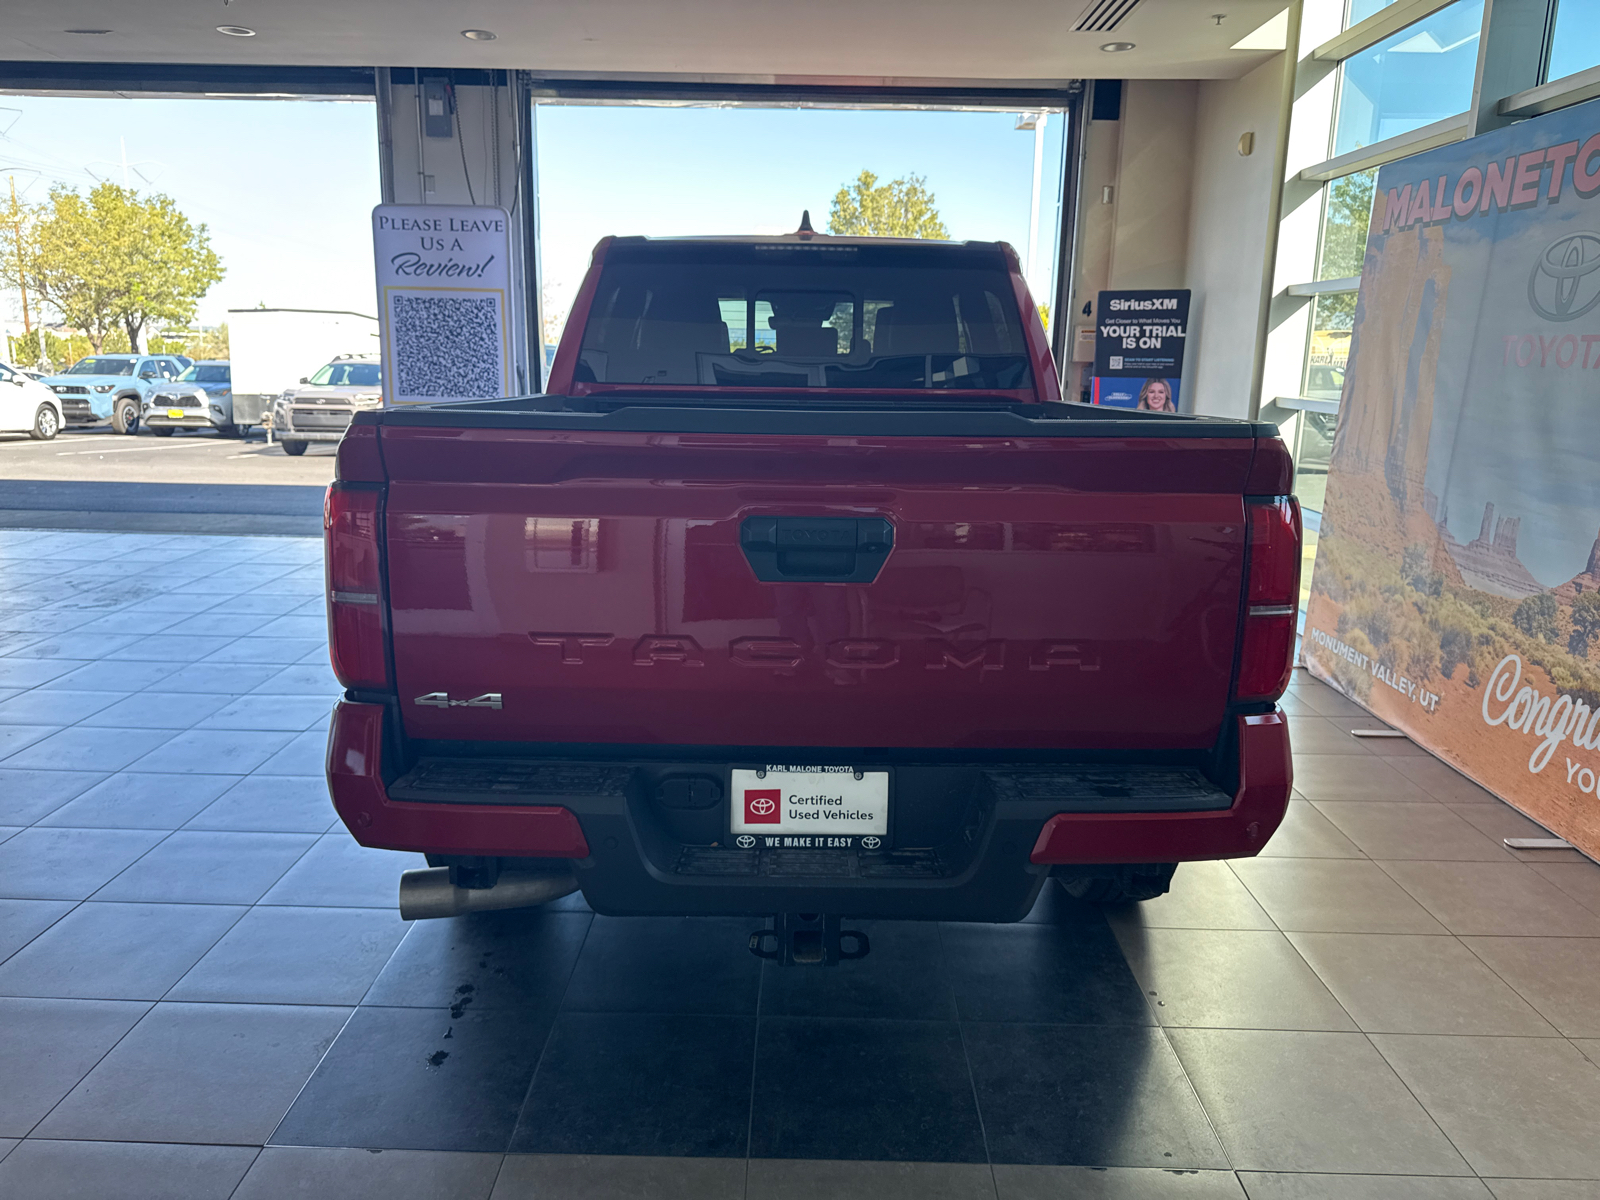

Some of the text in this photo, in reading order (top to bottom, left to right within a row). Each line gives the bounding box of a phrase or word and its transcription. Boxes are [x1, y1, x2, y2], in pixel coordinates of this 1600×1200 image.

[379, 216, 504, 233] PLEASE LEAVE
[450, 238, 465, 251] A
[391, 252, 495, 278] Review!
[1082, 300, 1092, 317] 4
[1109, 298, 1178, 311] SiriusXM
[1100, 325, 1140, 337] YOUR
[1143, 325, 1186, 337] TRIAL
[1122, 337, 1162, 349] IS ON
[1502, 333, 1600, 369] TOYOT
[781, 529, 850, 543] TOYOTA
[527, 630, 1100, 670] TACOMA
[1311, 627, 1439, 711] MONUMENT VALLEY, UT
[414, 692, 503, 709] 4x4
[766, 764, 787, 772] KARL
[789, 765, 822, 773] MALONE
[1566, 757, 1600, 801] YO
[788, 794, 843, 806] Certified
[788, 809, 874, 821] Used Vehicles
[765, 837, 853, 847] WE MAKE IT EASY
